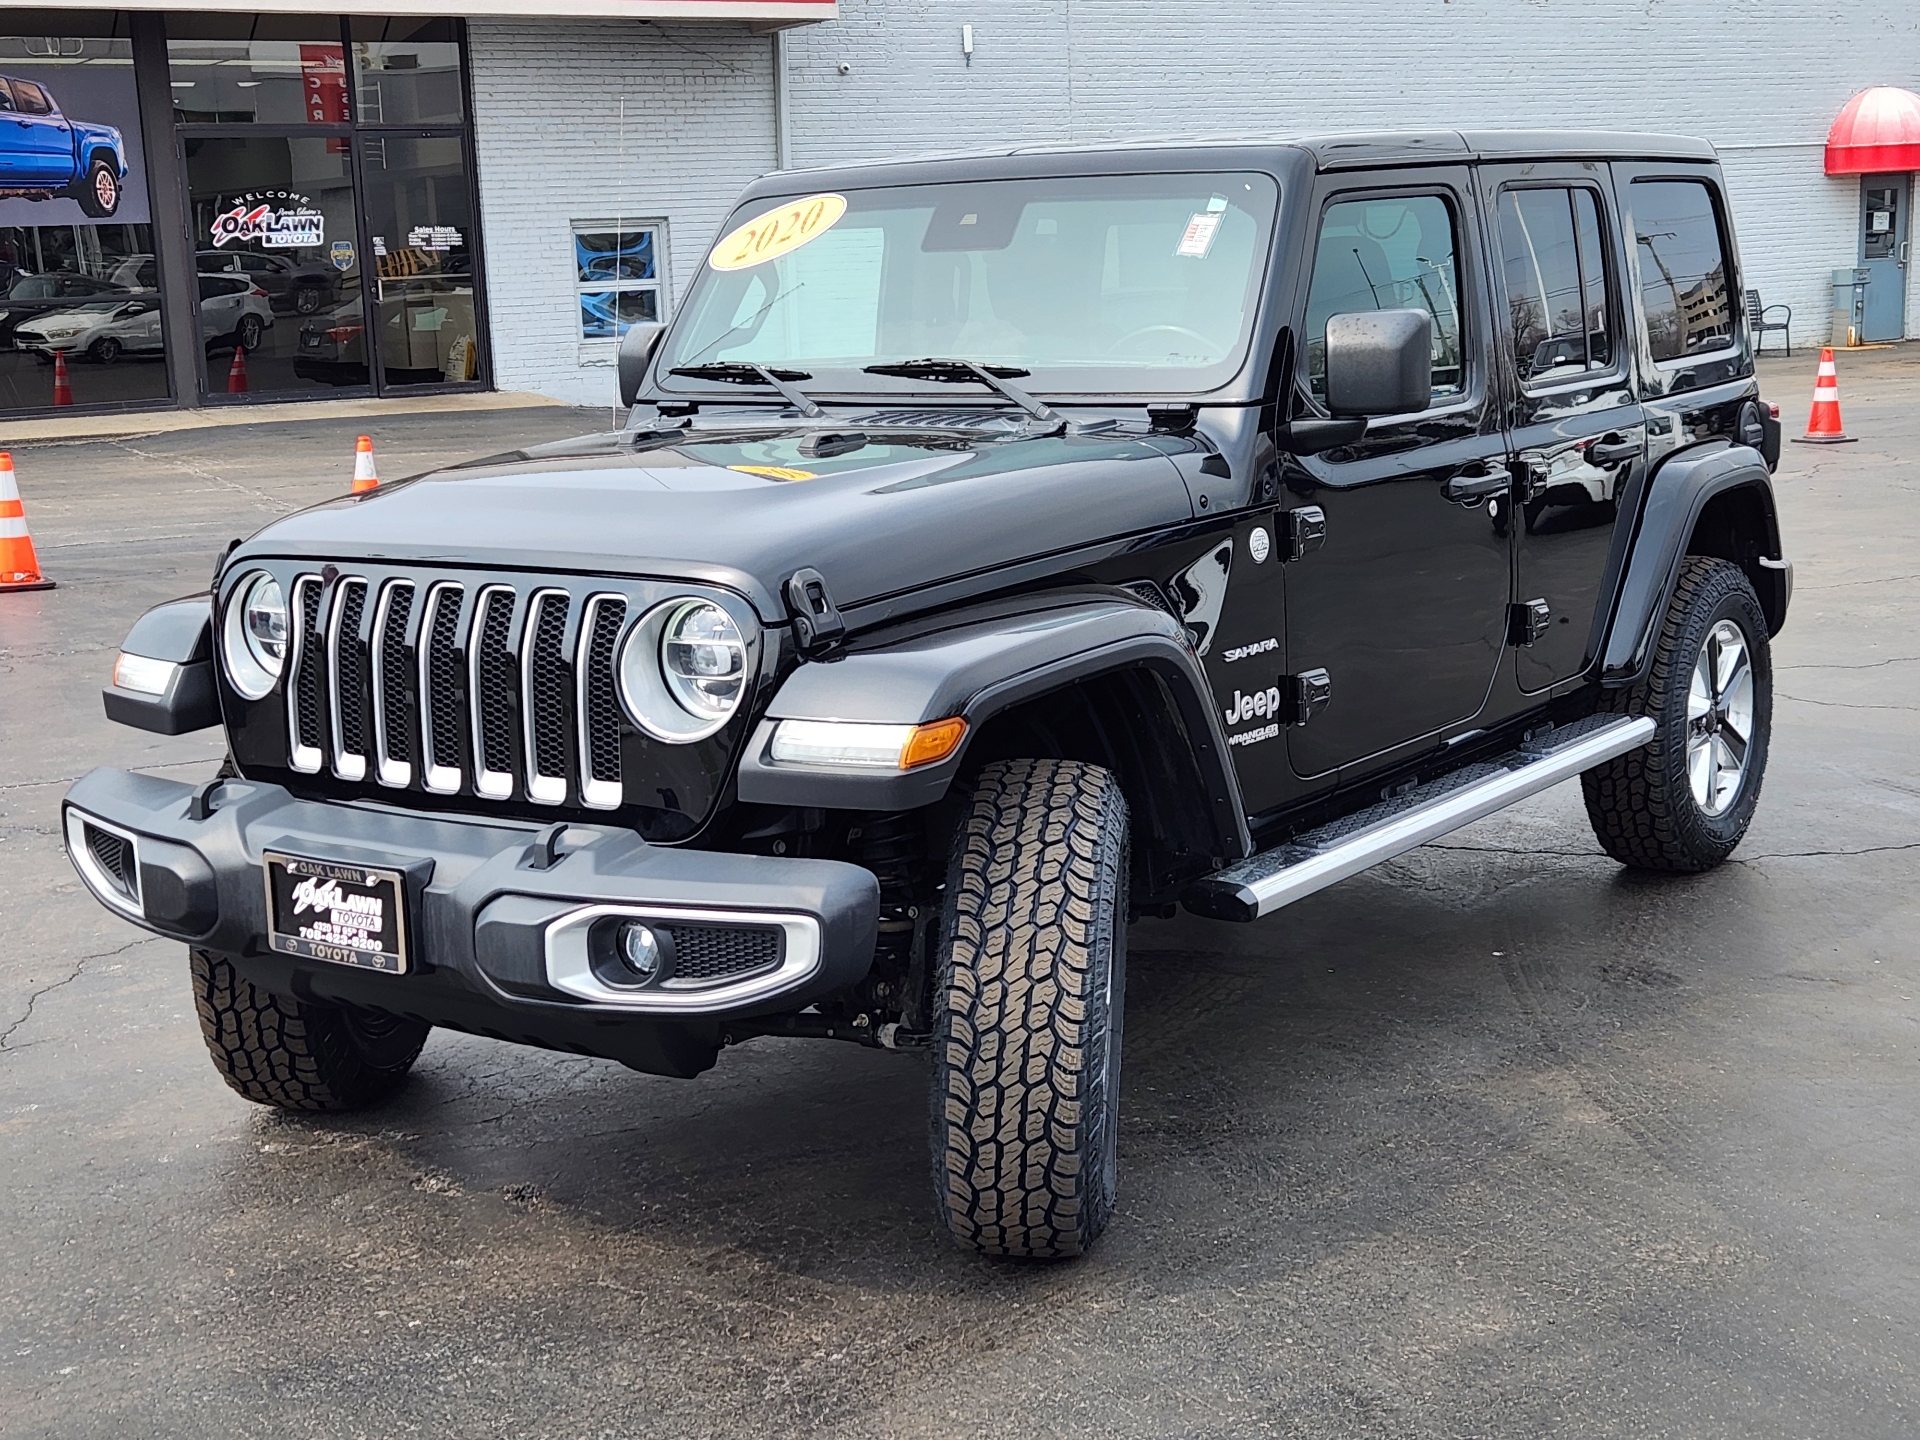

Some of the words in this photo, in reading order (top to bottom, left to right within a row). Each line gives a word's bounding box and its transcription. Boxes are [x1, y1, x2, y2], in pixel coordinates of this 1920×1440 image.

[231, 190, 311, 205] WELCOME
[269, 233, 319, 244] TOYOTA
[434, 225, 456, 233] Hours
[732, 201, 824, 262] 2020
[1222, 637, 1279, 662] SAHARA
[1225, 686, 1280, 725] Jeep
[1229, 723, 1279, 746] WRANGLER
[1242, 730, 1279, 746] UNLIMITED
[300, 861, 325, 875] OAK
[326, 866, 362, 881] LAWN
[332, 925, 341, 934] W
[337, 911, 376, 929] TOYOTA
[309, 943, 358, 964] TOYOTA
